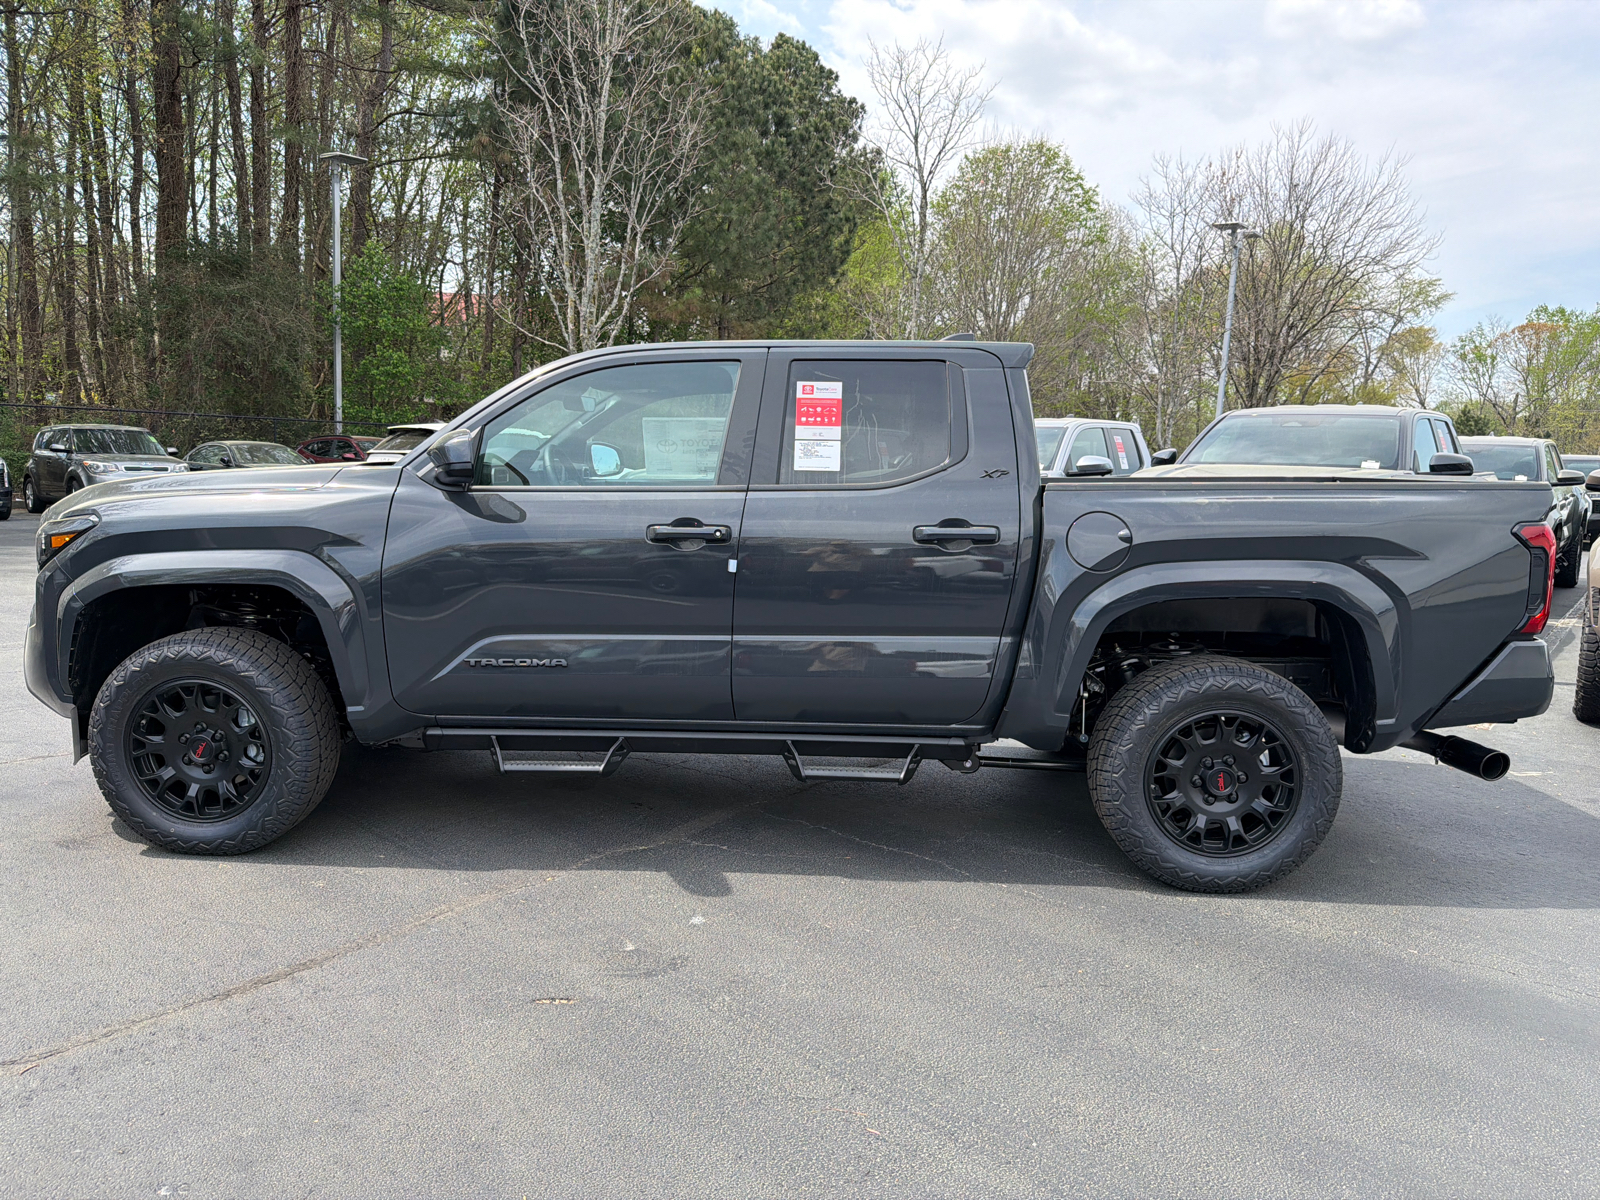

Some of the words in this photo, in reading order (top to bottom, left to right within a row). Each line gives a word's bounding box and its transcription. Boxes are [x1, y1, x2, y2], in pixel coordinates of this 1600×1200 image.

[979, 468, 1010, 478] XP
[463, 658, 568, 668] TACOMA
[195, 741, 207, 758] TRD
[1217, 771, 1225, 791] TRD
